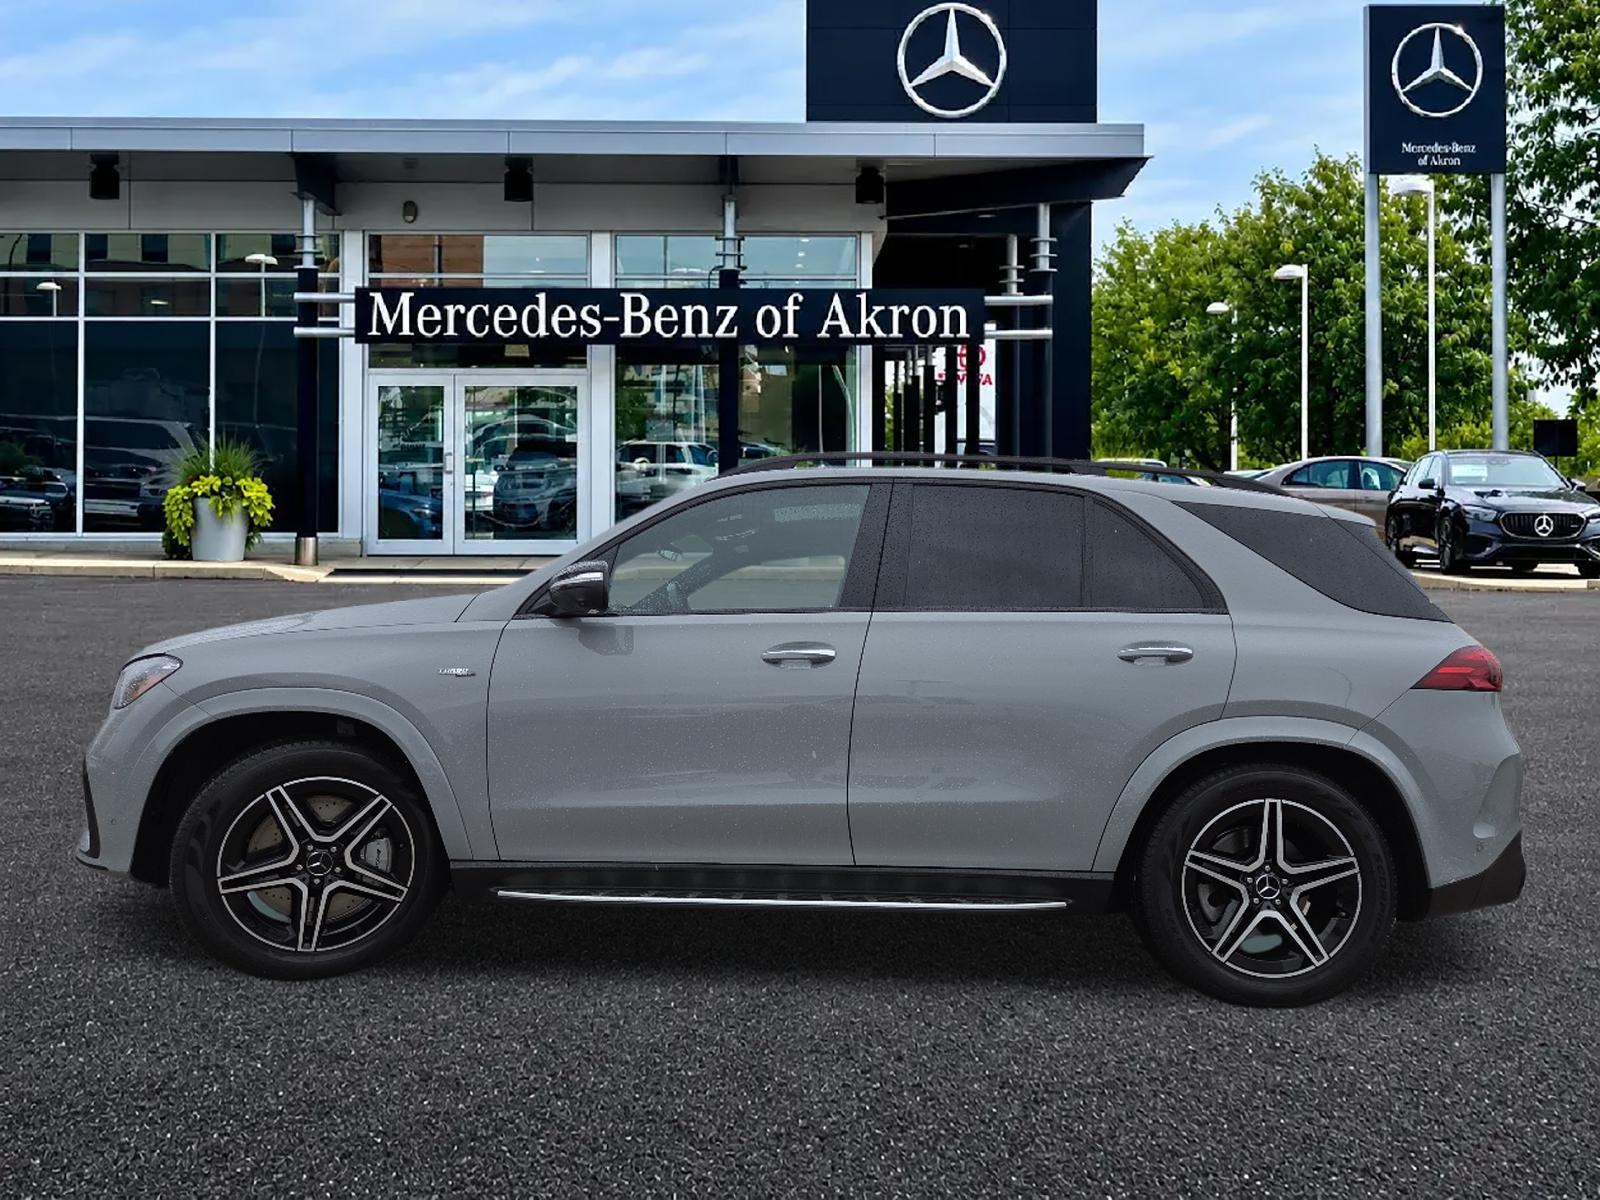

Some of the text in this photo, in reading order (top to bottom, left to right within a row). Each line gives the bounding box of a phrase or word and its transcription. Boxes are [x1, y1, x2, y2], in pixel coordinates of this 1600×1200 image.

[1401, 142, 1477, 154] Mercedes-Benz
[1417, 154, 1461, 166] of Akron
[367, 291, 971, 338] Mercedes-Benz of Akron
